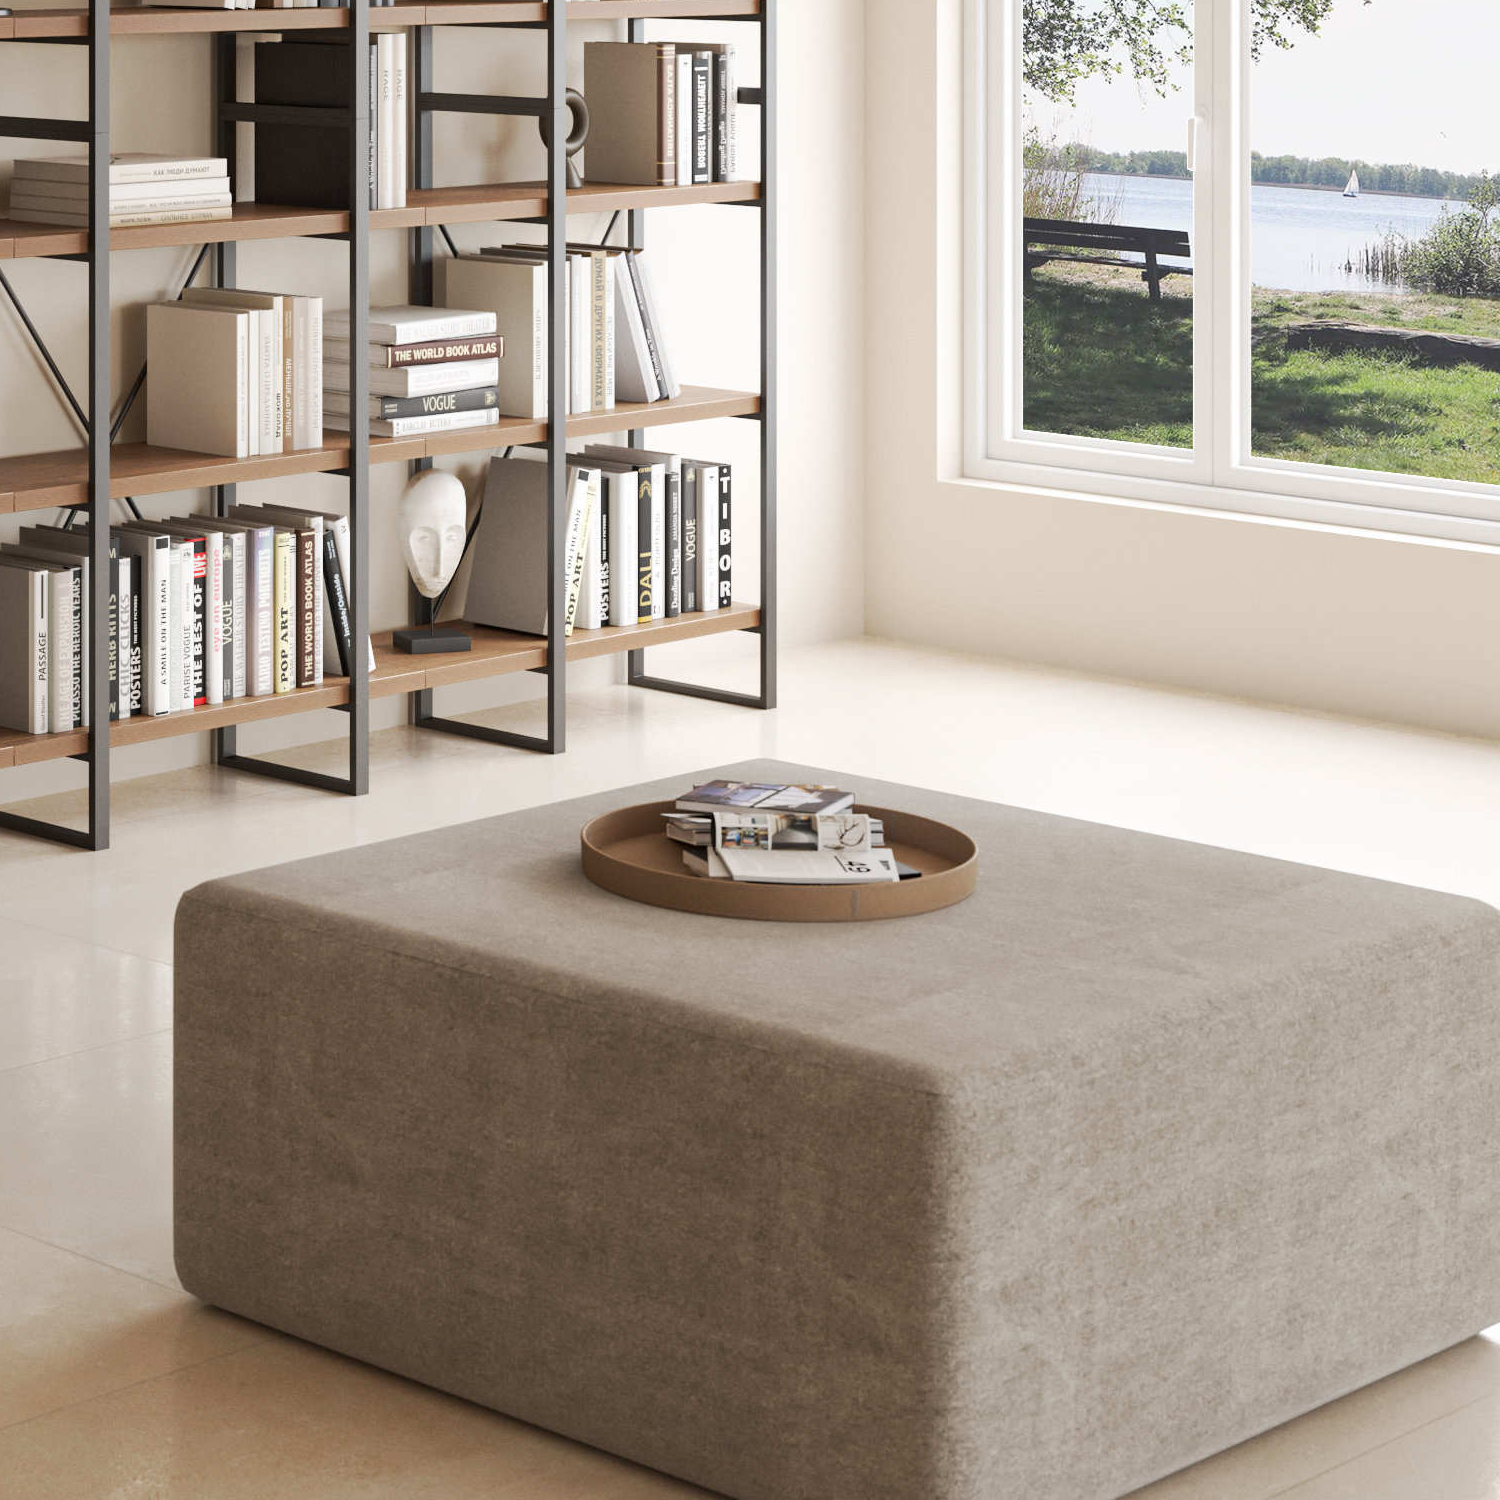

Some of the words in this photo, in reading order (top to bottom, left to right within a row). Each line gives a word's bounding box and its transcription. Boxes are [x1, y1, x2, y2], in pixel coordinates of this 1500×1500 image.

[595, 257, 603, 292] ДУМАЙ
[595, 294, 603, 302] В
[595, 304, 603, 343] ДРУГИХ
[395, 350, 412, 361] THE
[413, 347, 444, 360] WORLD
[445, 345, 470, 357] BOOK
[471, 342, 497, 354] ATLAS
[595, 345, 603, 397] ФОРМАТАХ
[422, 394, 456, 412] VOGUE
[719, 475, 731, 598] TIBOR
[639, 552, 652, 607] DALI
[38, 632, 47, 681] PASSAGE
[130, 646, 141, 710] POSTERS
